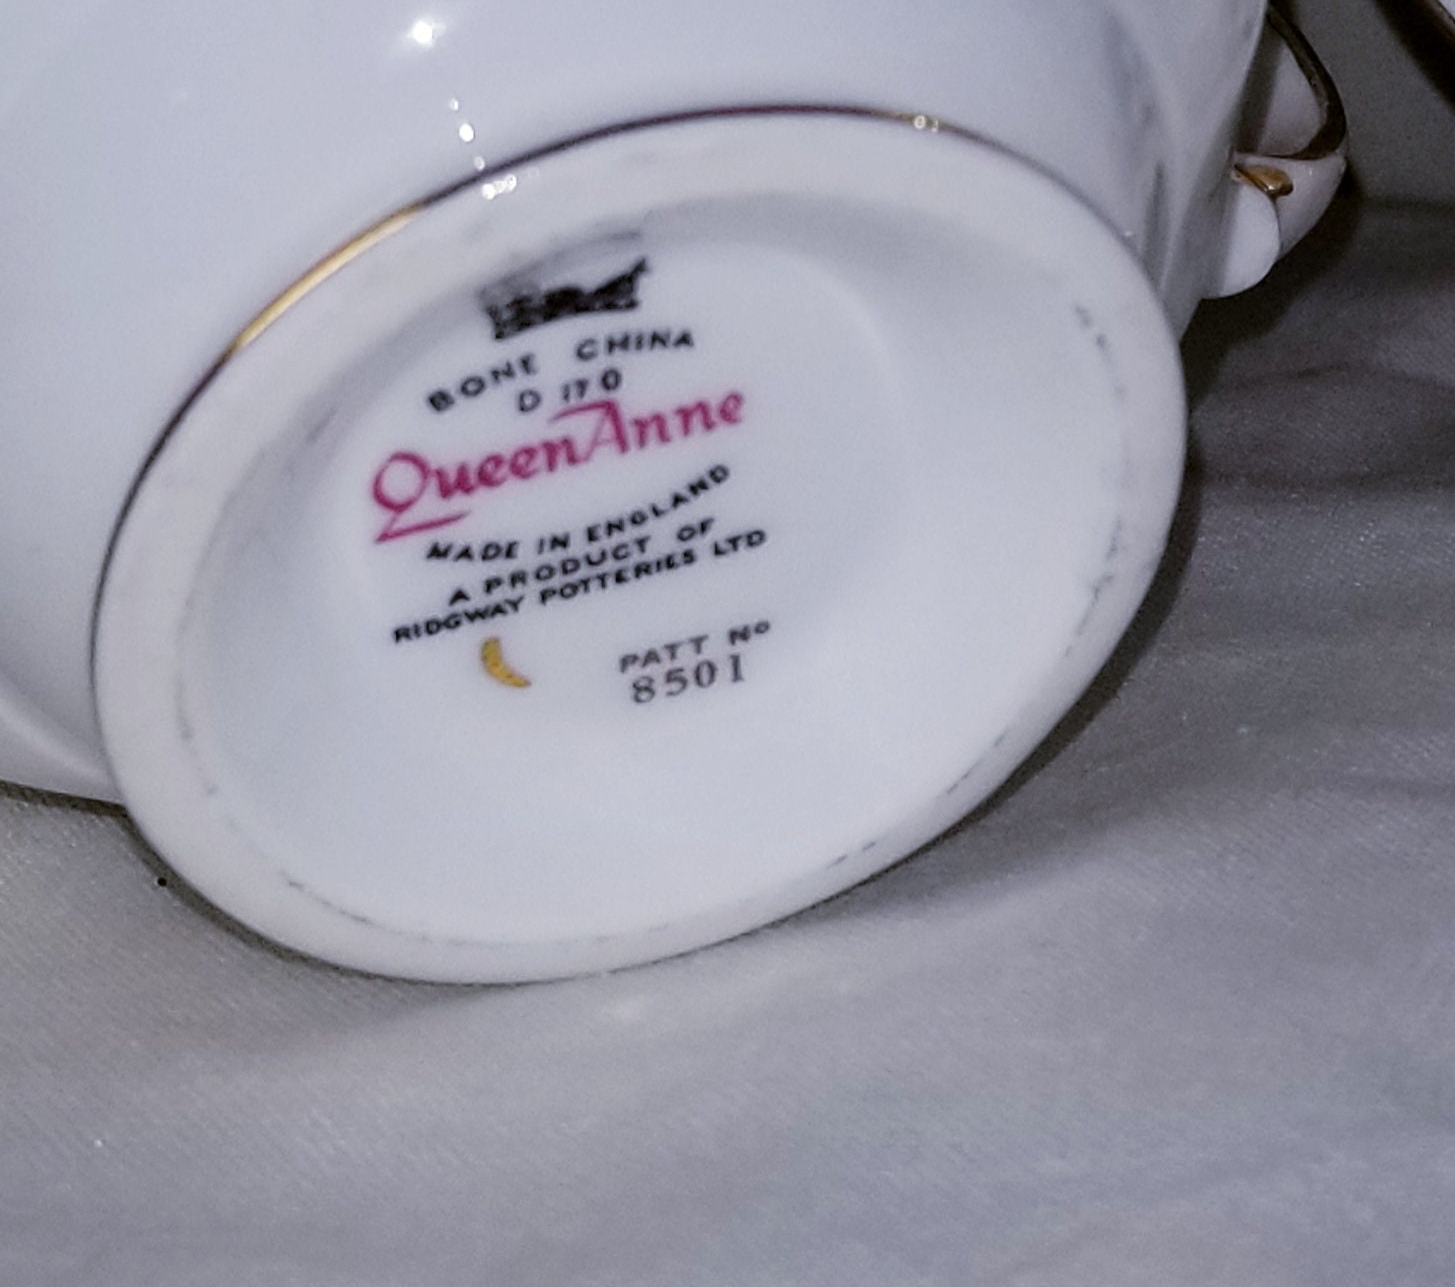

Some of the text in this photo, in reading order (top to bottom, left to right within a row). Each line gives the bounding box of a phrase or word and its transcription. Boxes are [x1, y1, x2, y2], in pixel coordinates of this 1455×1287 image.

[426, 328, 694, 413] BONE CHINA
[426, 464, 730, 560] MADE IN ENGLAND
[392, 529, 766, 644] RIDGWAY POTTERIES LTD
[448, 518, 715, 607] A PRODUCT OF
[619, 637, 708, 672] PATT
[631, 654, 745, 704] 8501
